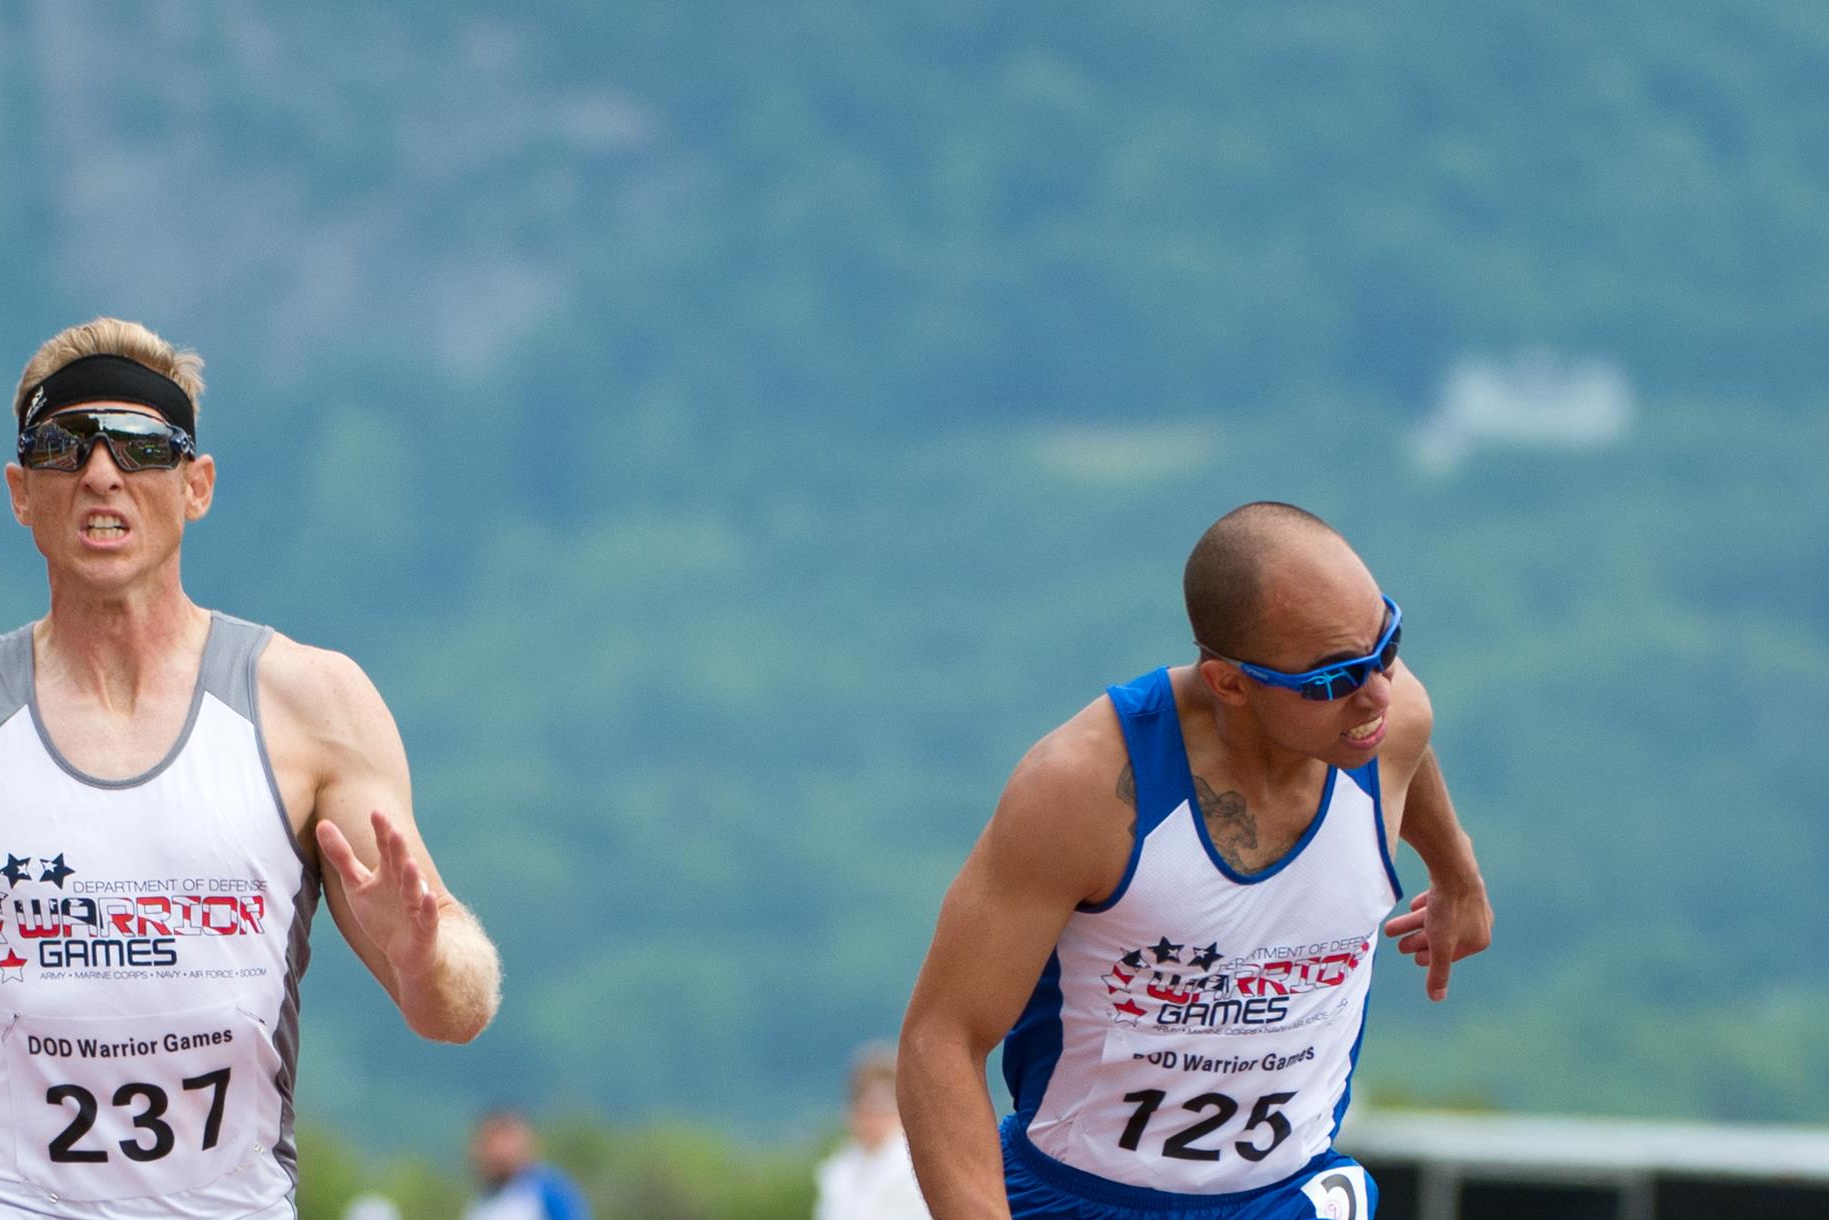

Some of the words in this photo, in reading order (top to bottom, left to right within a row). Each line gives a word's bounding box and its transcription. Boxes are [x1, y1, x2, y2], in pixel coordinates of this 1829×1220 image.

[73, 879, 178, 894] DEPARTMENT
[182, 878, 205, 891] OF
[208, 878, 268, 893] DEFENSE
[13, 895, 266, 939] WARRIOR
[39, 938, 178, 968] GAMES
[40, 971, 66, 980] ARMY
[74, 971, 111, 980] MARINE
[113, 971, 148, 980] CORPS
[156, 970, 181, 979] NAVY
[190, 970, 204, 979] AIR
[205, 970, 234, 979] FORCE
[1157, 997, 1290, 1027] GAMES
[28, 1035, 73, 1058] DOD
[77, 1037, 158, 1058] Warrior
[163, 1029, 233, 1053] Games
[1183, 1052, 1258, 1074] Warrior
[1261, 1046, 1316, 1071] Games
[45, 1067, 232, 1164] 237
[1118, 1088, 1298, 1163] 125
